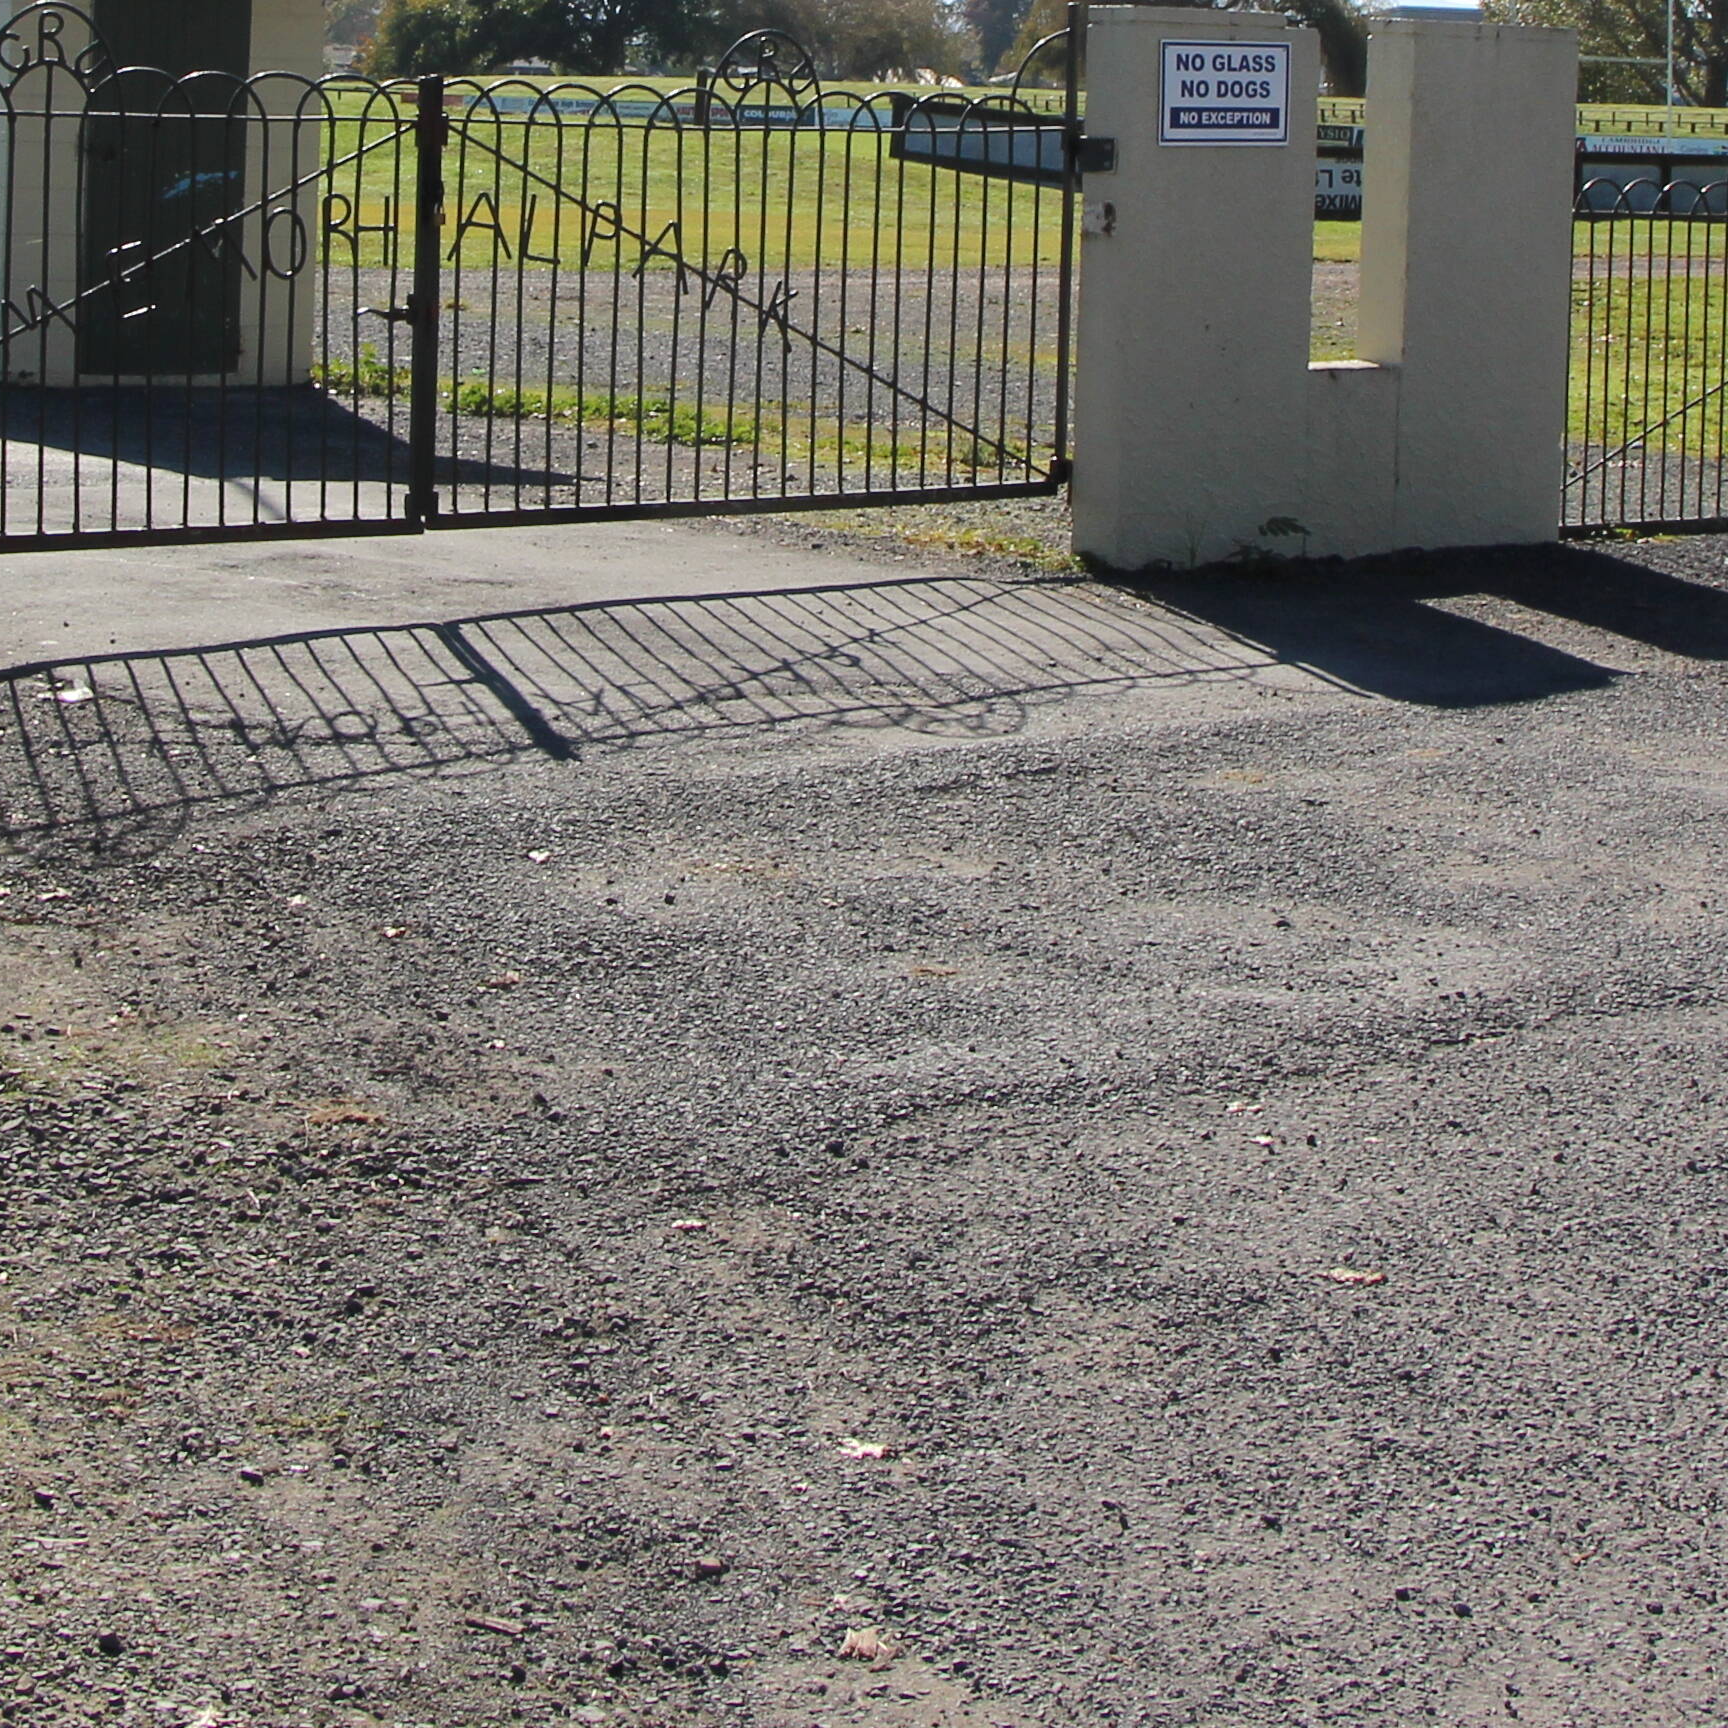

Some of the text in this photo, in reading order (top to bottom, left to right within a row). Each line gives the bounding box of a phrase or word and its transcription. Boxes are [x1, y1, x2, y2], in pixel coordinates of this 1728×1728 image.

[1175, 53, 1276, 73] NO GLASS
[1180, 80, 1271, 99] NO DOGS
[1179, 111, 1271, 125] NO EXCEPTION
[584, 199, 799, 353] PARK
